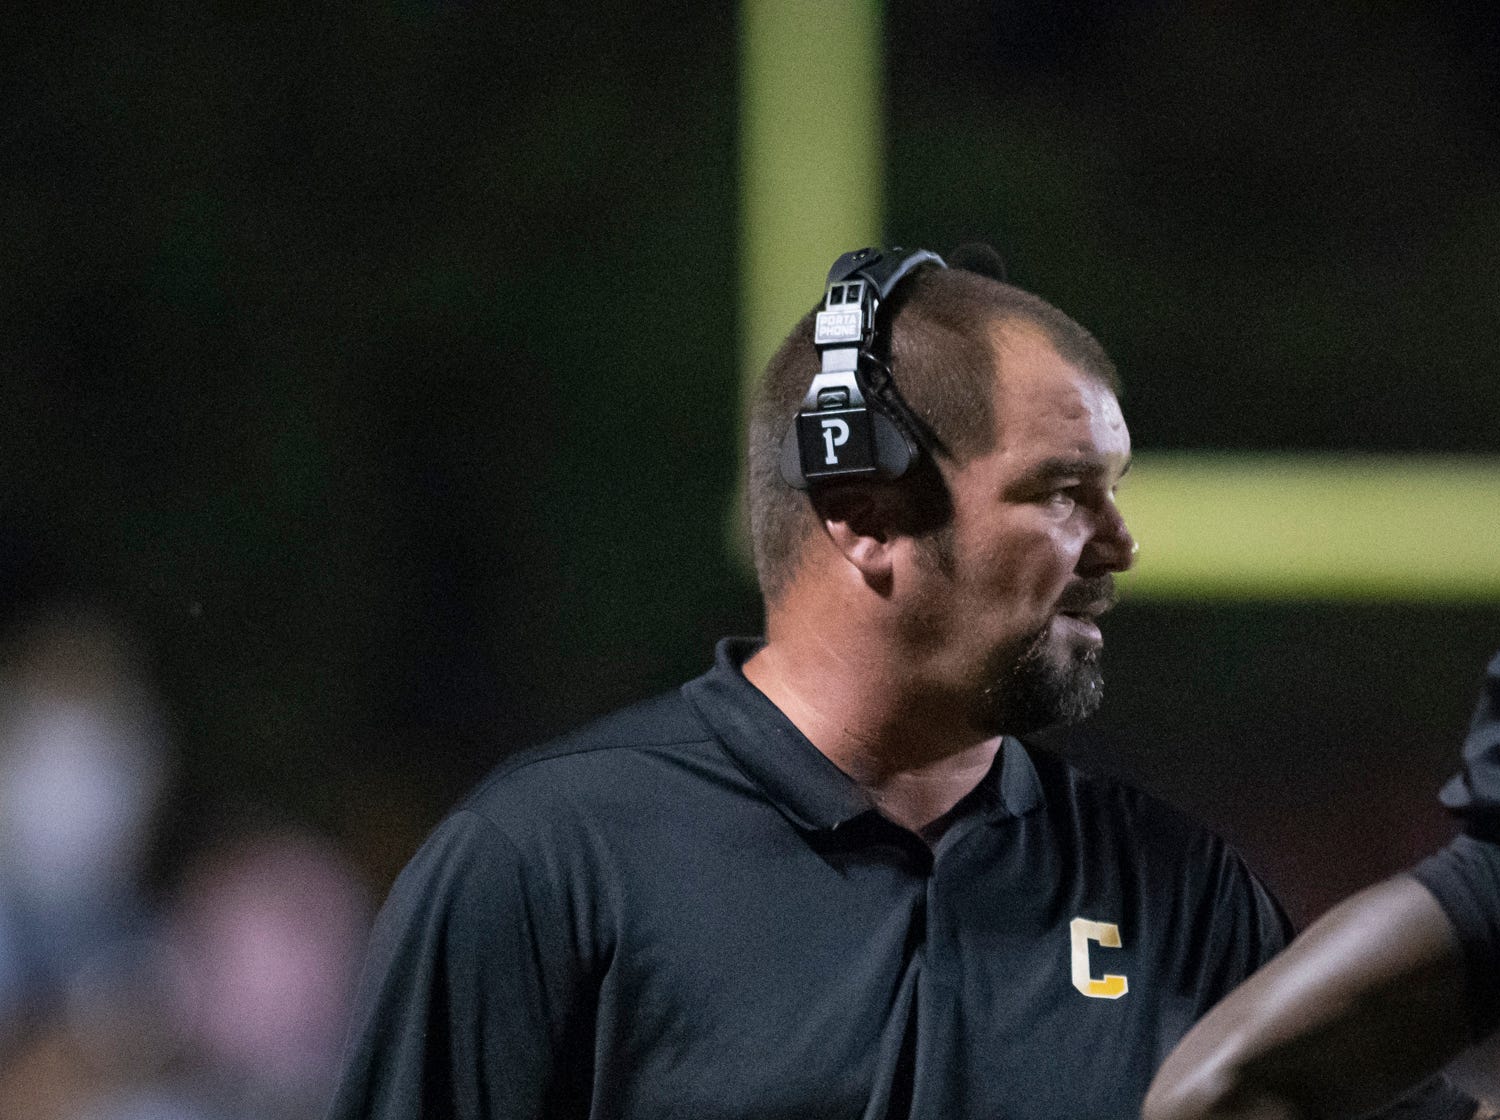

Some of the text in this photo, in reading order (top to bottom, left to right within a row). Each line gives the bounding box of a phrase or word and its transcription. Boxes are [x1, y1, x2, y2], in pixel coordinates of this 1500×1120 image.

[819, 314, 857, 325] PORTA
[819, 325, 857, 337] PHONE
[821, 418, 850, 465] P
[1069, 917, 1129, 999] C
